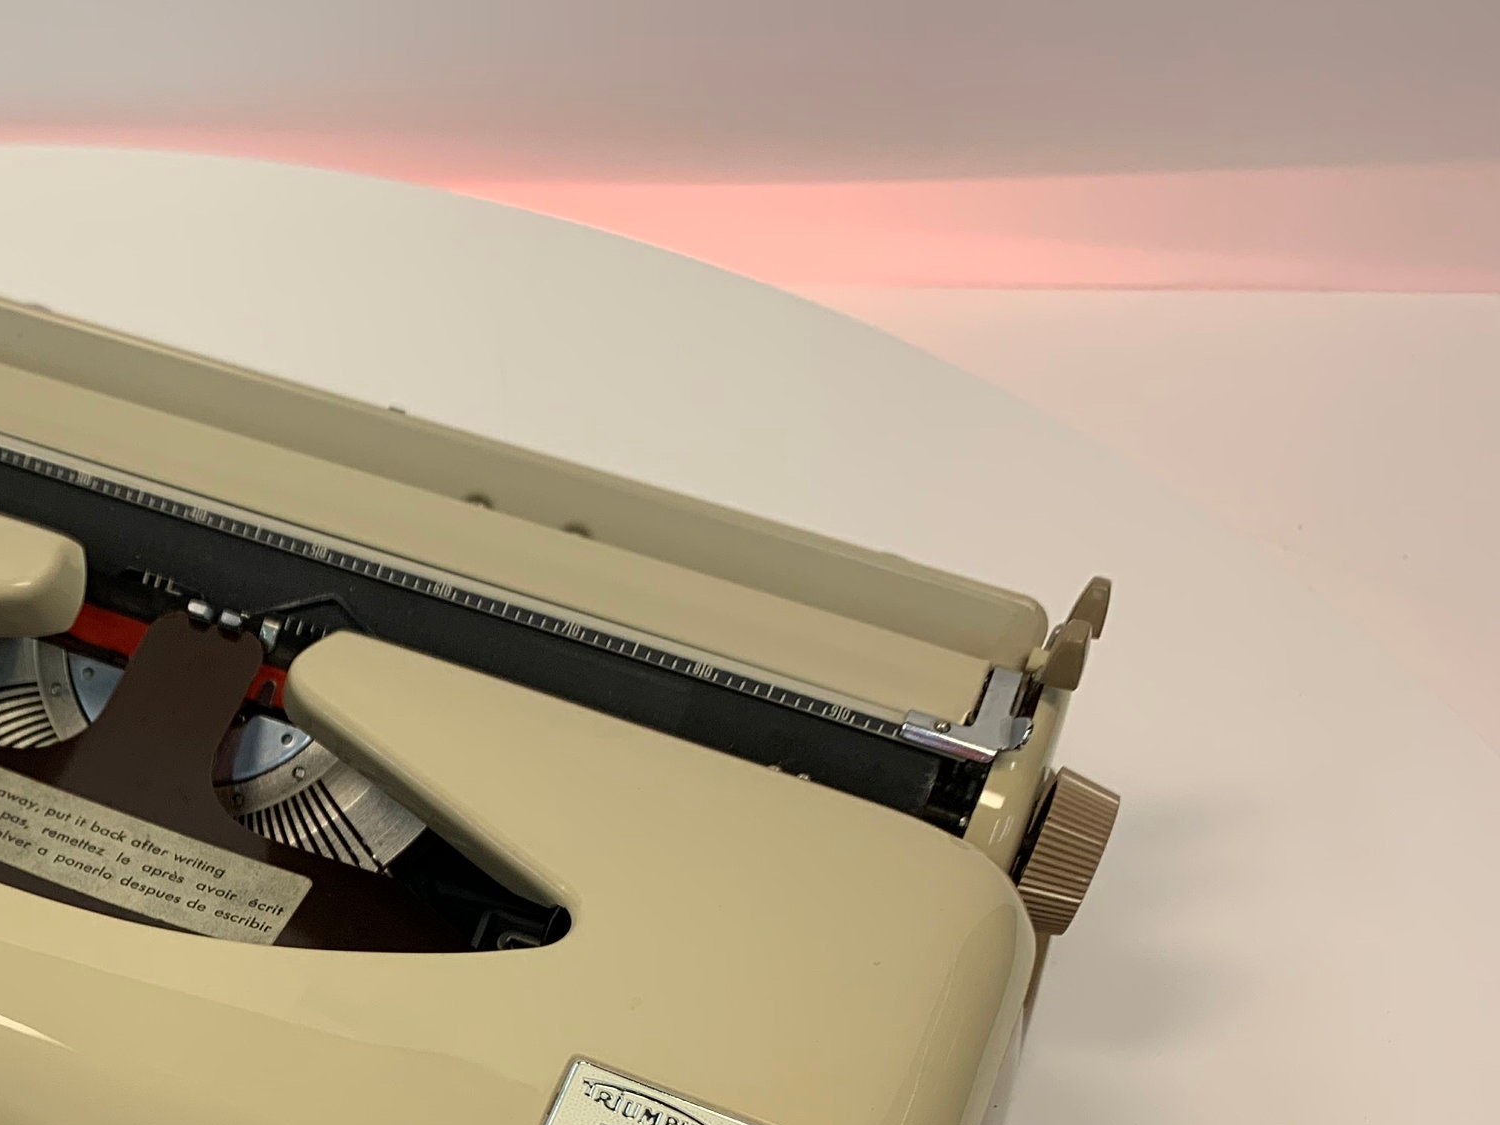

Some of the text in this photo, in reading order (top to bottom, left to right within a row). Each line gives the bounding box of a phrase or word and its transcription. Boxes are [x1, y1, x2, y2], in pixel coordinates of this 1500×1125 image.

[41, 826, 105, 856] remettez
[116, 851, 130, 865] le
[141, 864, 185, 884] après
[195, 881, 238, 901] avoir
[248, 898, 285, 917] écrit
[44, 807, 71, 823] put
[74, 816, 86, 828] it
[90, 820, 128, 843] back
[131, 838, 169, 856] after
[174, 853, 226, 879] writing
[37, 846, 48, 856] a
[53, 854, 113, 880] ponerlo
[120, 875, 181, 904] despues
[186, 898, 207, 912] de
[214, 910, 273, 934] escribir
